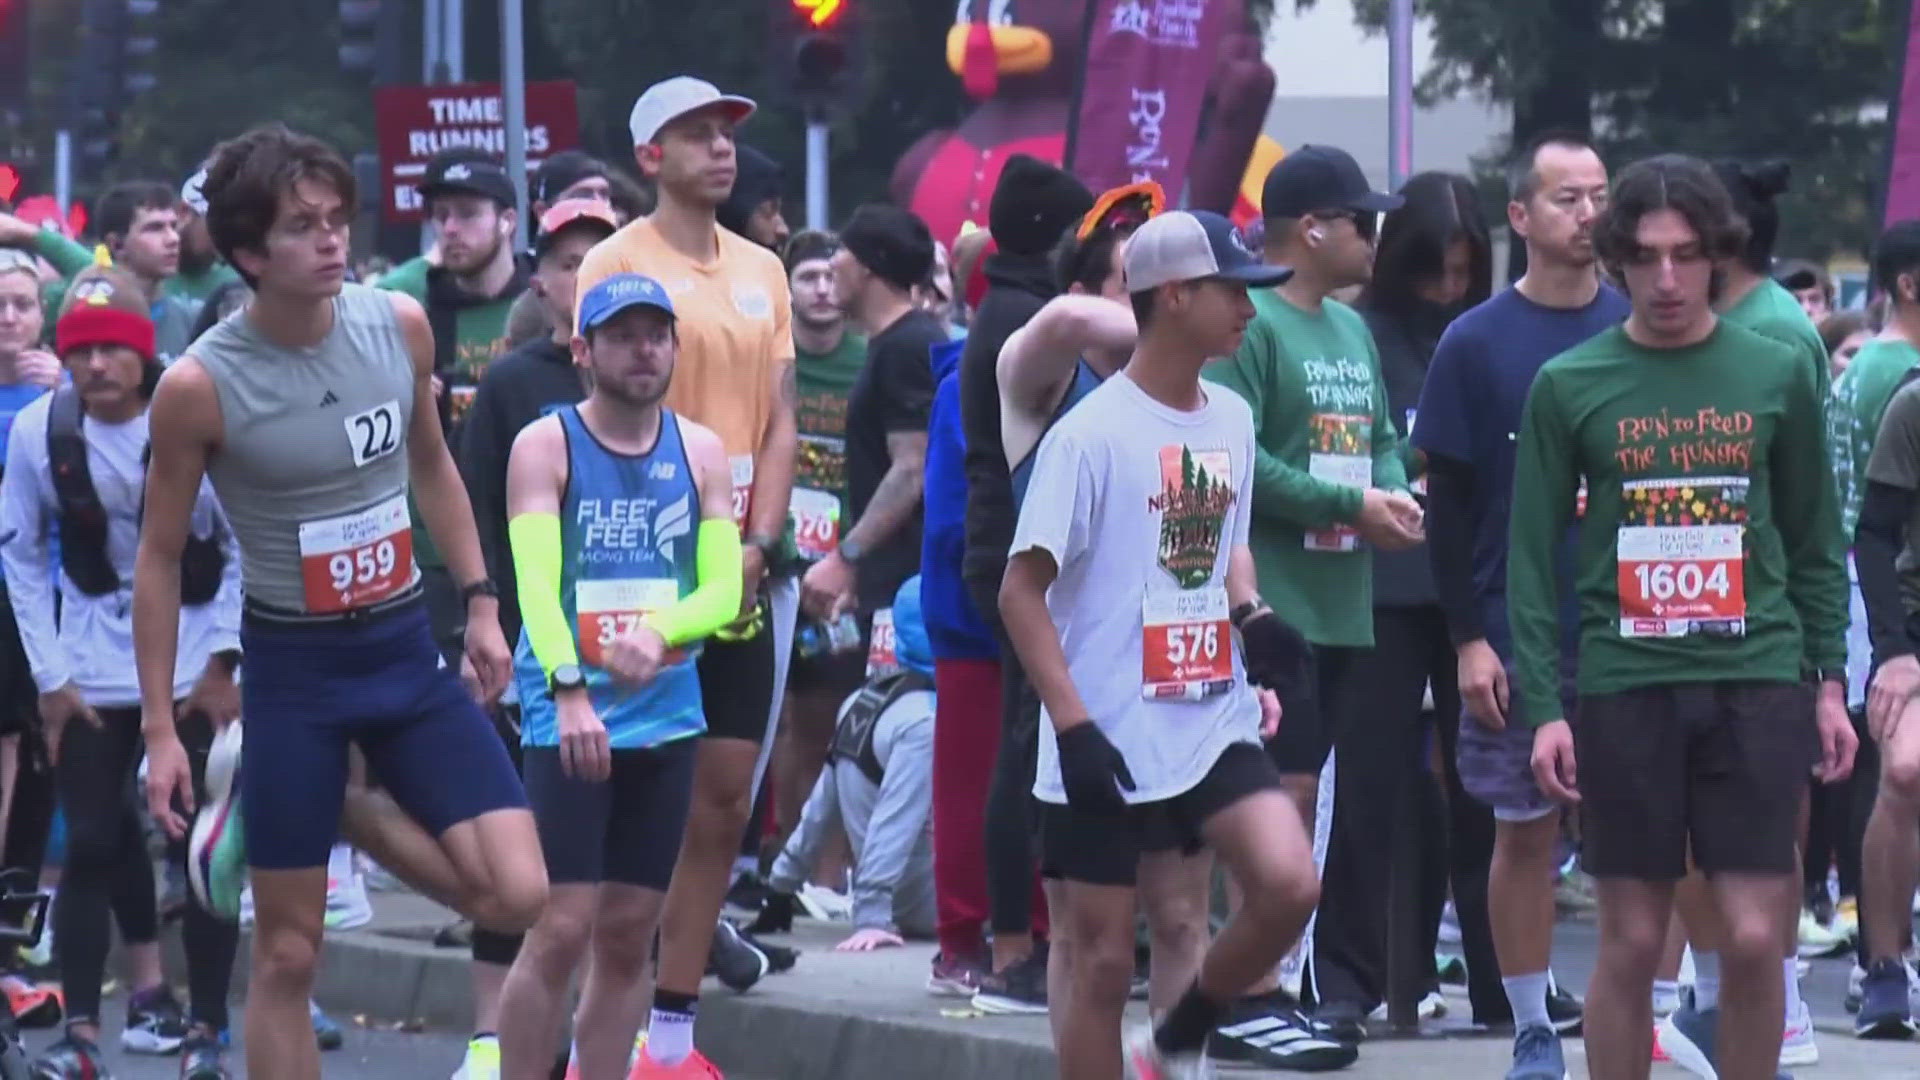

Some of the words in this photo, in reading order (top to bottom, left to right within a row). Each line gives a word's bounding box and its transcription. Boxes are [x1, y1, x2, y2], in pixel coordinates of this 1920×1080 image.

[355, 407, 394, 460] 22
[577, 499, 658, 525] FLEET
[585, 523, 650, 549] FEET
[329, 539, 396, 592] 959
[1634, 562, 1730, 600] 1604
[1166, 623, 1218, 664] 576
